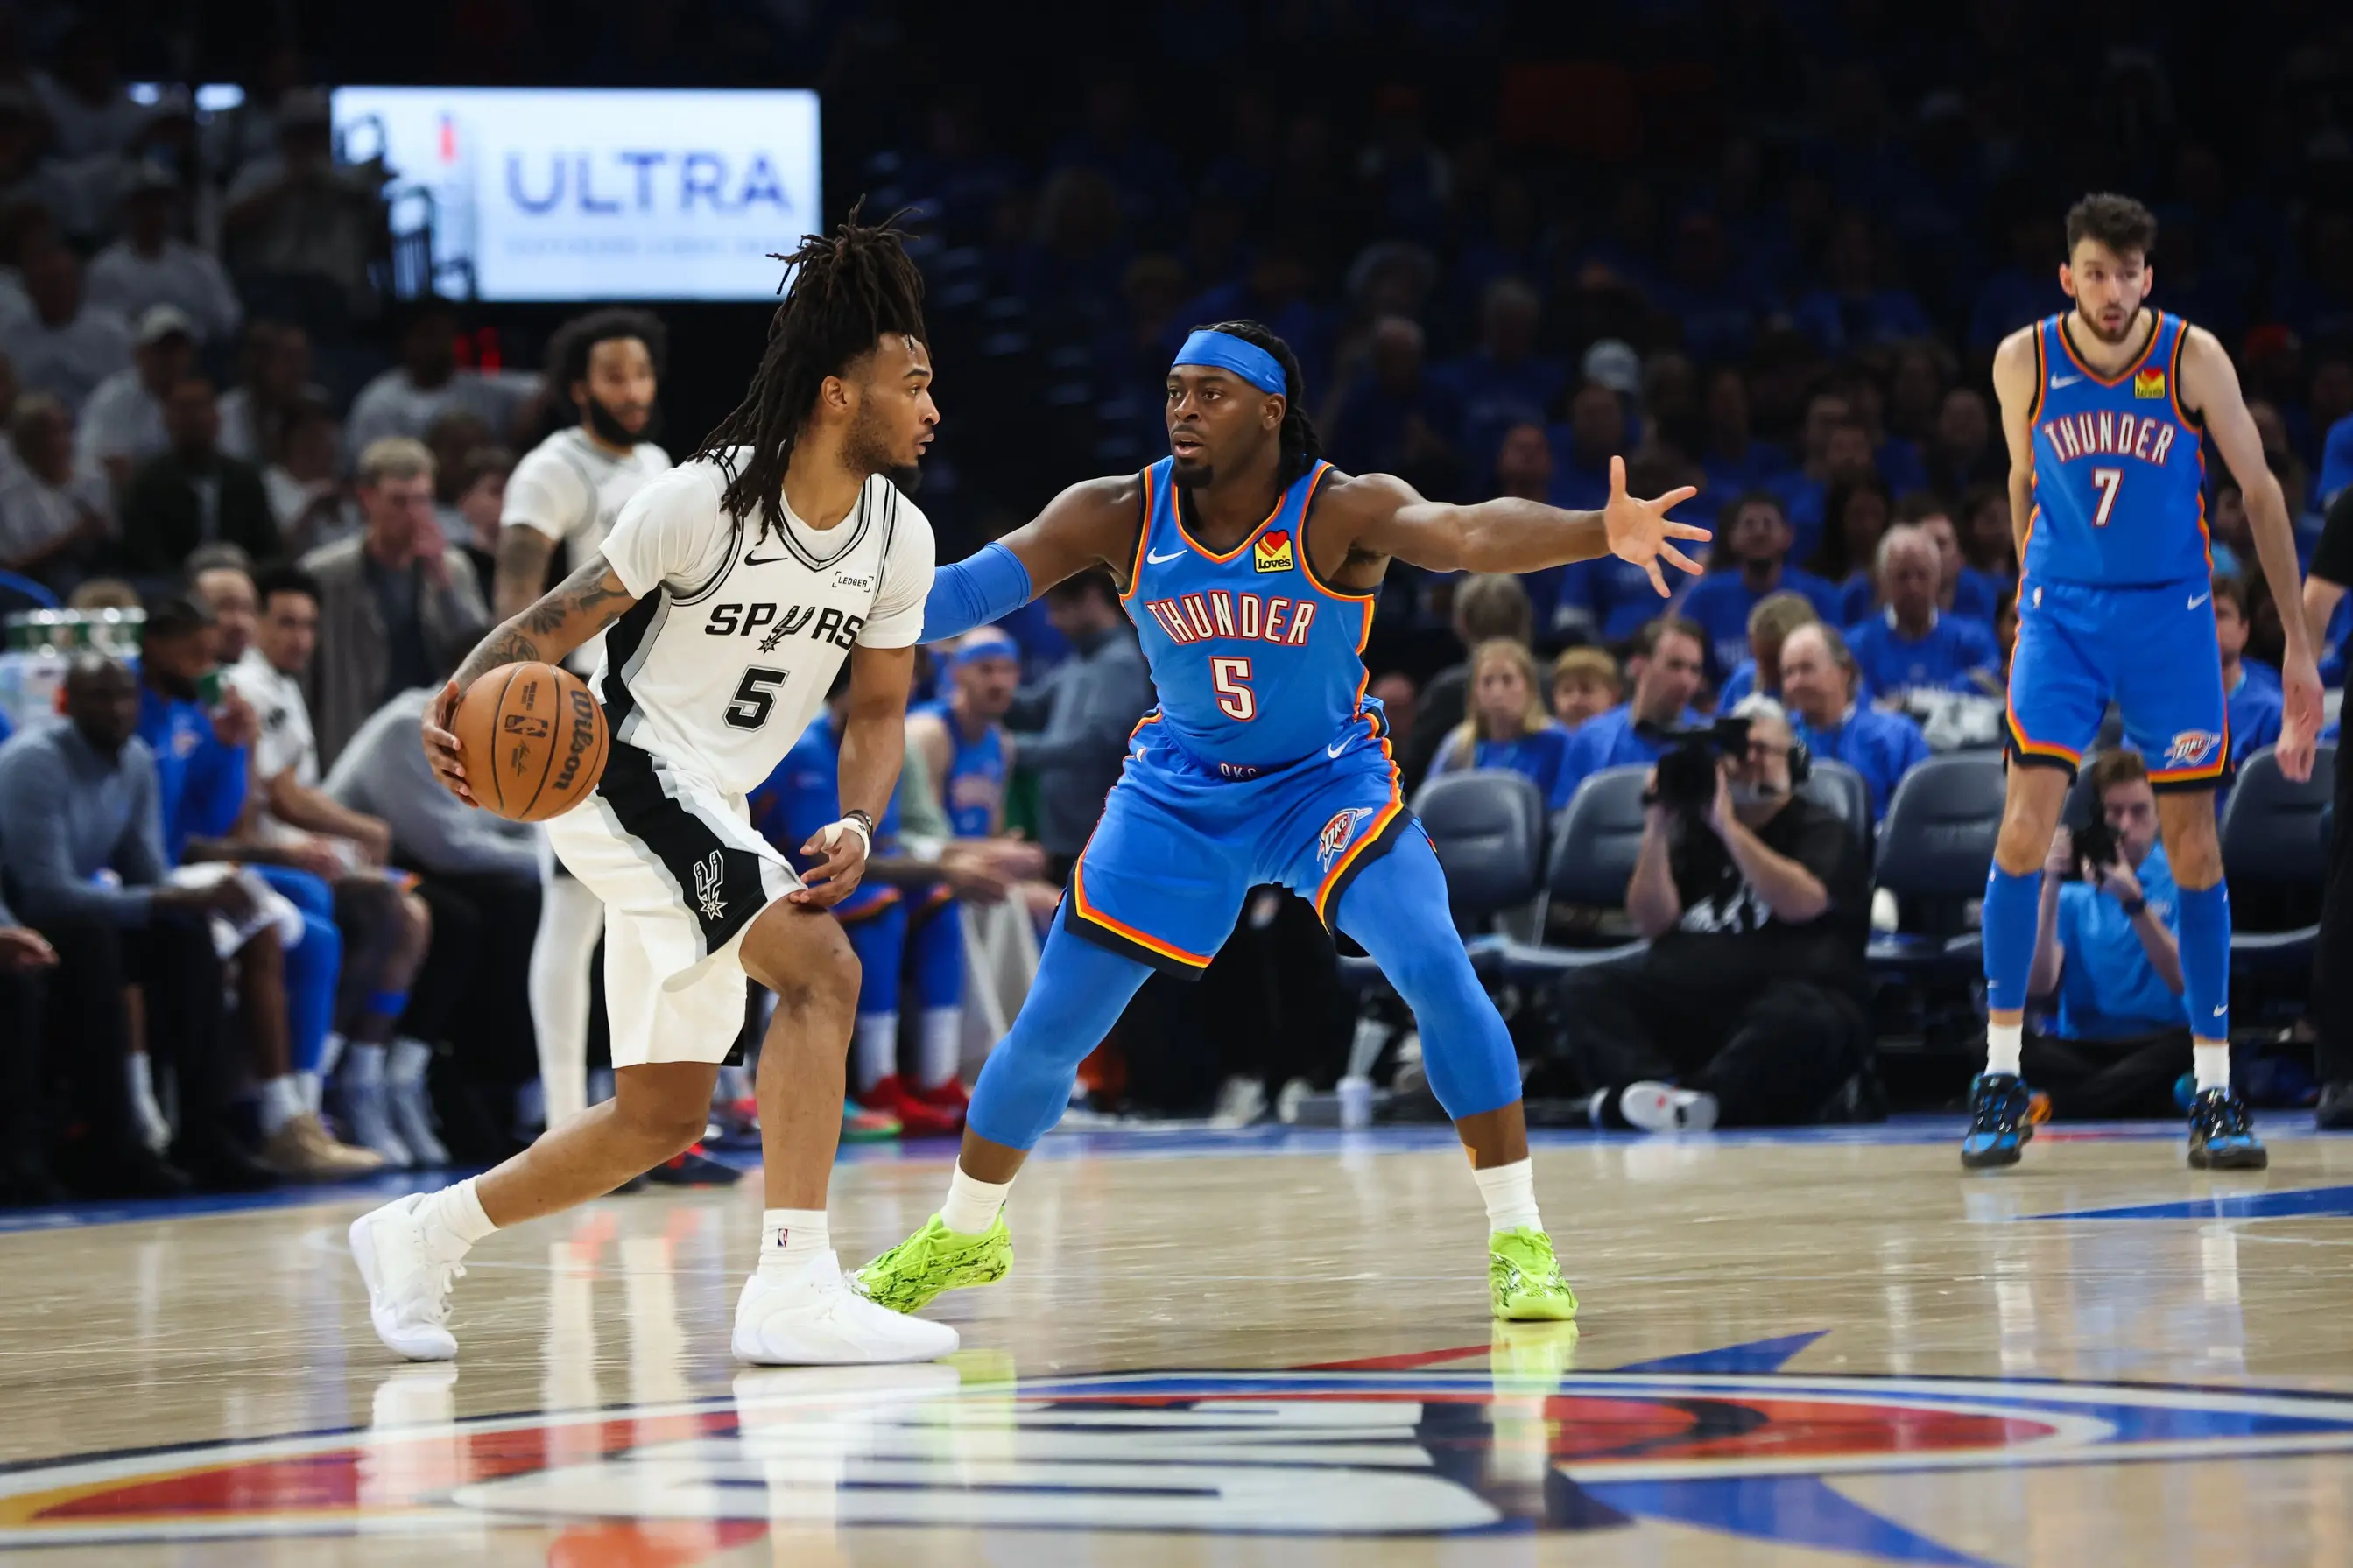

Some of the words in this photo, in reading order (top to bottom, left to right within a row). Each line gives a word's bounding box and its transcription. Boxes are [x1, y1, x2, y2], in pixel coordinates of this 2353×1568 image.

[504, 150, 794, 215] ULTRA
[2042, 410, 2175, 467] THUNDER
[2092, 466, 2124, 528] 7
[837, 575, 868, 588] LEDGER
[704, 602, 865, 655] SPURS
[1145, 590, 1317, 646] THUNDER
[722, 664, 790, 733] 5
[1209, 656, 1258, 721] 5
[552, 689, 595, 791] Wilson
[1323, 815, 1348, 857] OKC
